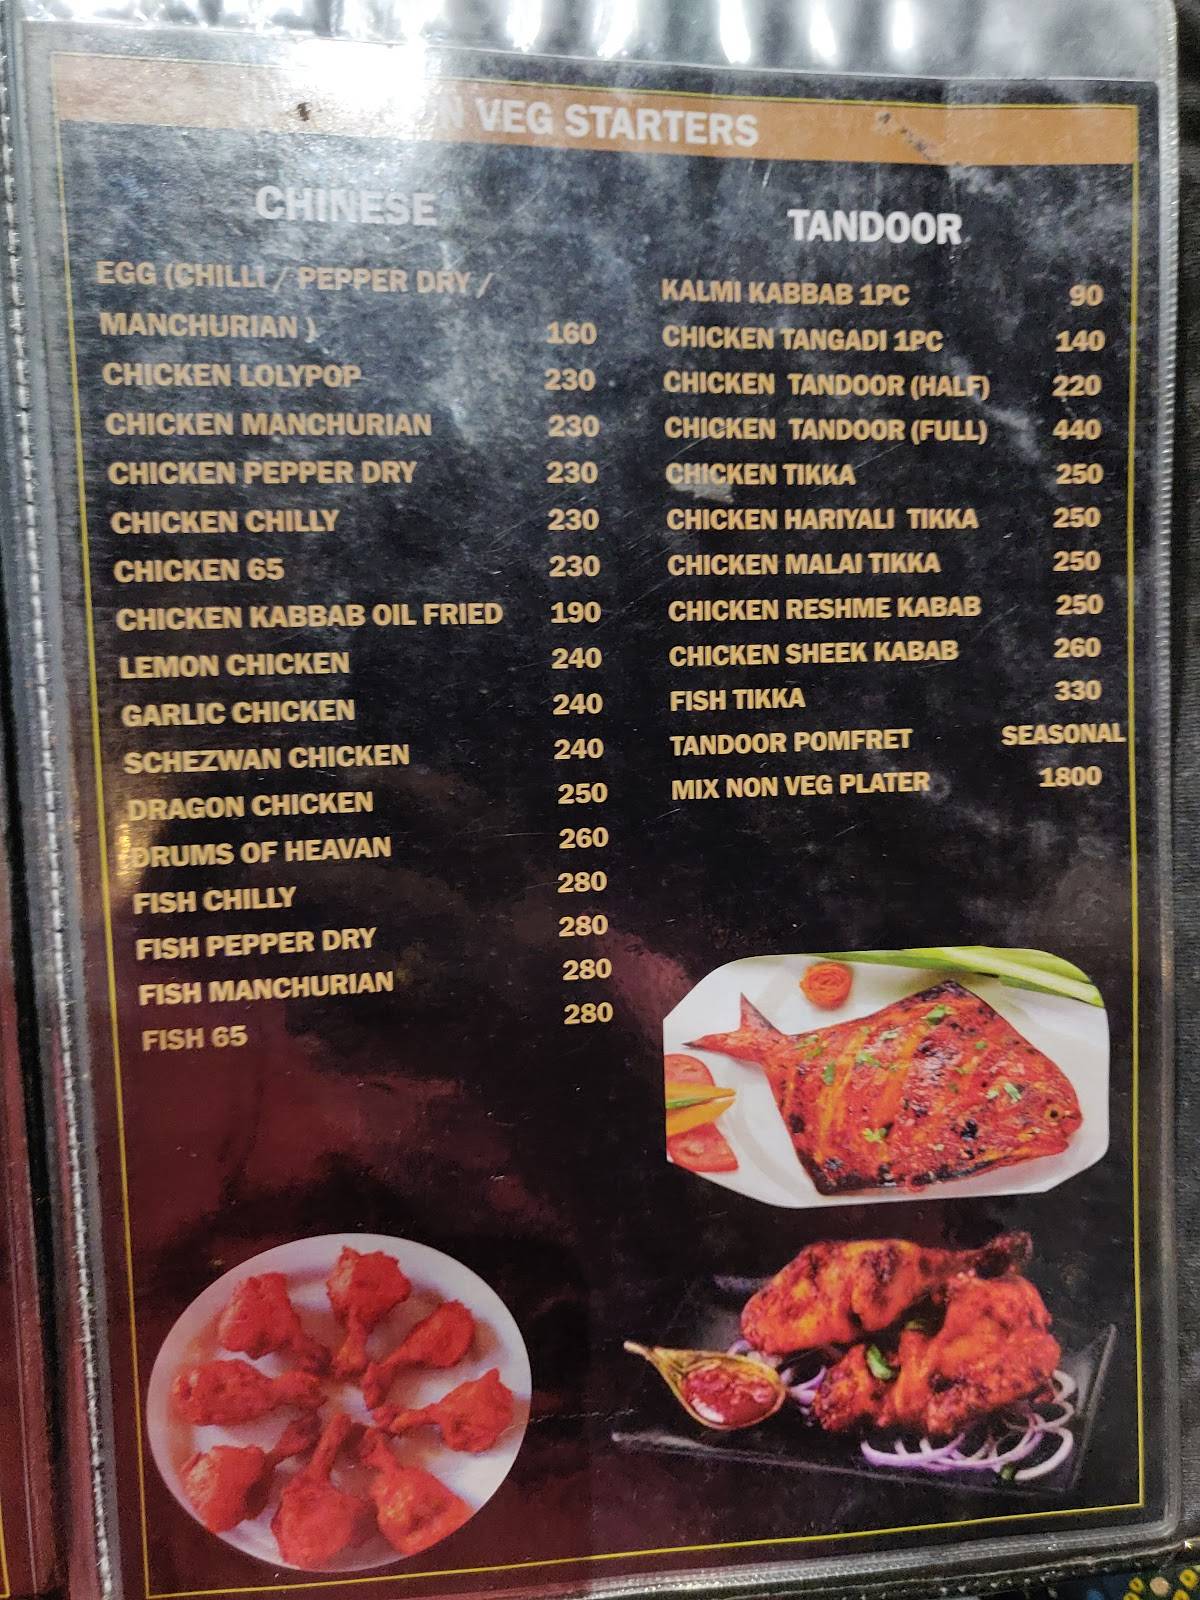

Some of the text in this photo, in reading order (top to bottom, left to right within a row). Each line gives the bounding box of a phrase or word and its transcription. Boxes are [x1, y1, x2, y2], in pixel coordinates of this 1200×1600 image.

[476, 98, 553, 136] VEG
[565, 103, 760, 147] STARTERS
[255, 185, 438, 228] CHINESE
[787, 208, 963, 245] TANDOOR
[96, 260, 156, 286] EGG
[299, 266, 408, 293] PEPPER
[416, 270, 472, 294] DRY
[661, 278, 1104, 307] KALMI KABBAB 1PC 90
[100, 312, 298, 339] MANCHURIAN
[547, 321, 597, 345] 160
[662, 325, 1106, 353] CHICKEN TANGADI 1PC 140
[103, 362, 597, 392] CHICKEN LOLYPOP 230
[663, 370, 1102, 401] CHICKEN TANDOOR (HALF) 220
[105, 411, 600, 437] CHICKEN MANCHURIAN 230
[664, 416, 1102, 445] CHICKEN TANDOOR (FULL) 440
[108, 460, 599, 485] CHICKEN PEPPER DRY 230
[665, 462, 1104, 486] CHICKEN TIKKA 250
[110, 508, 600, 535] CHICKEN CHILLY 230
[666, 507, 1101, 531] CHICKEN HARIYALI TIKKA 250
[113, 554, 600, 584] CHICKEN 65 230
[667, 551, 1101, 577] CHICKEN MALAI TIKKA 250
[115, 602, 602, 632] CHICKEN KABBAB OIL FRIED 190
[668, 594, 1104, 623] CHICKEN RESHME KABAB 250
[119, 647, 602, 680] LEMON CHICKEN 240
[669, 637, 1101, 668] CHICKEN SHEEK KABAB 260
[121, 693, 603, 729] GARLIC CHICKEN 240
[670, 680, 1101, 712] FISH TIKKA 330
[670, 722, 1127, 757] TANDOOR POMFRET SEASONAL
[124, 738, 604, 775] SCHEZWAN CHICKEN 240
[672, 765, 1102, 801] MIX NON VEG PLATER 1800
[128, 782, 609, 822] DRAGON CHICKEN 250
[131, 827, 609, 868] DRUMS OF HEAVAN 260
[133, 870, 608, 915] FISH CHILLY 280
[136, 914, 609, 961] FISH PEPPER DRY 280
[138, 957, 612, 1006] FISH MANCHURIAN 280
[142, 1002, 614, 1052] FISH 65 280
